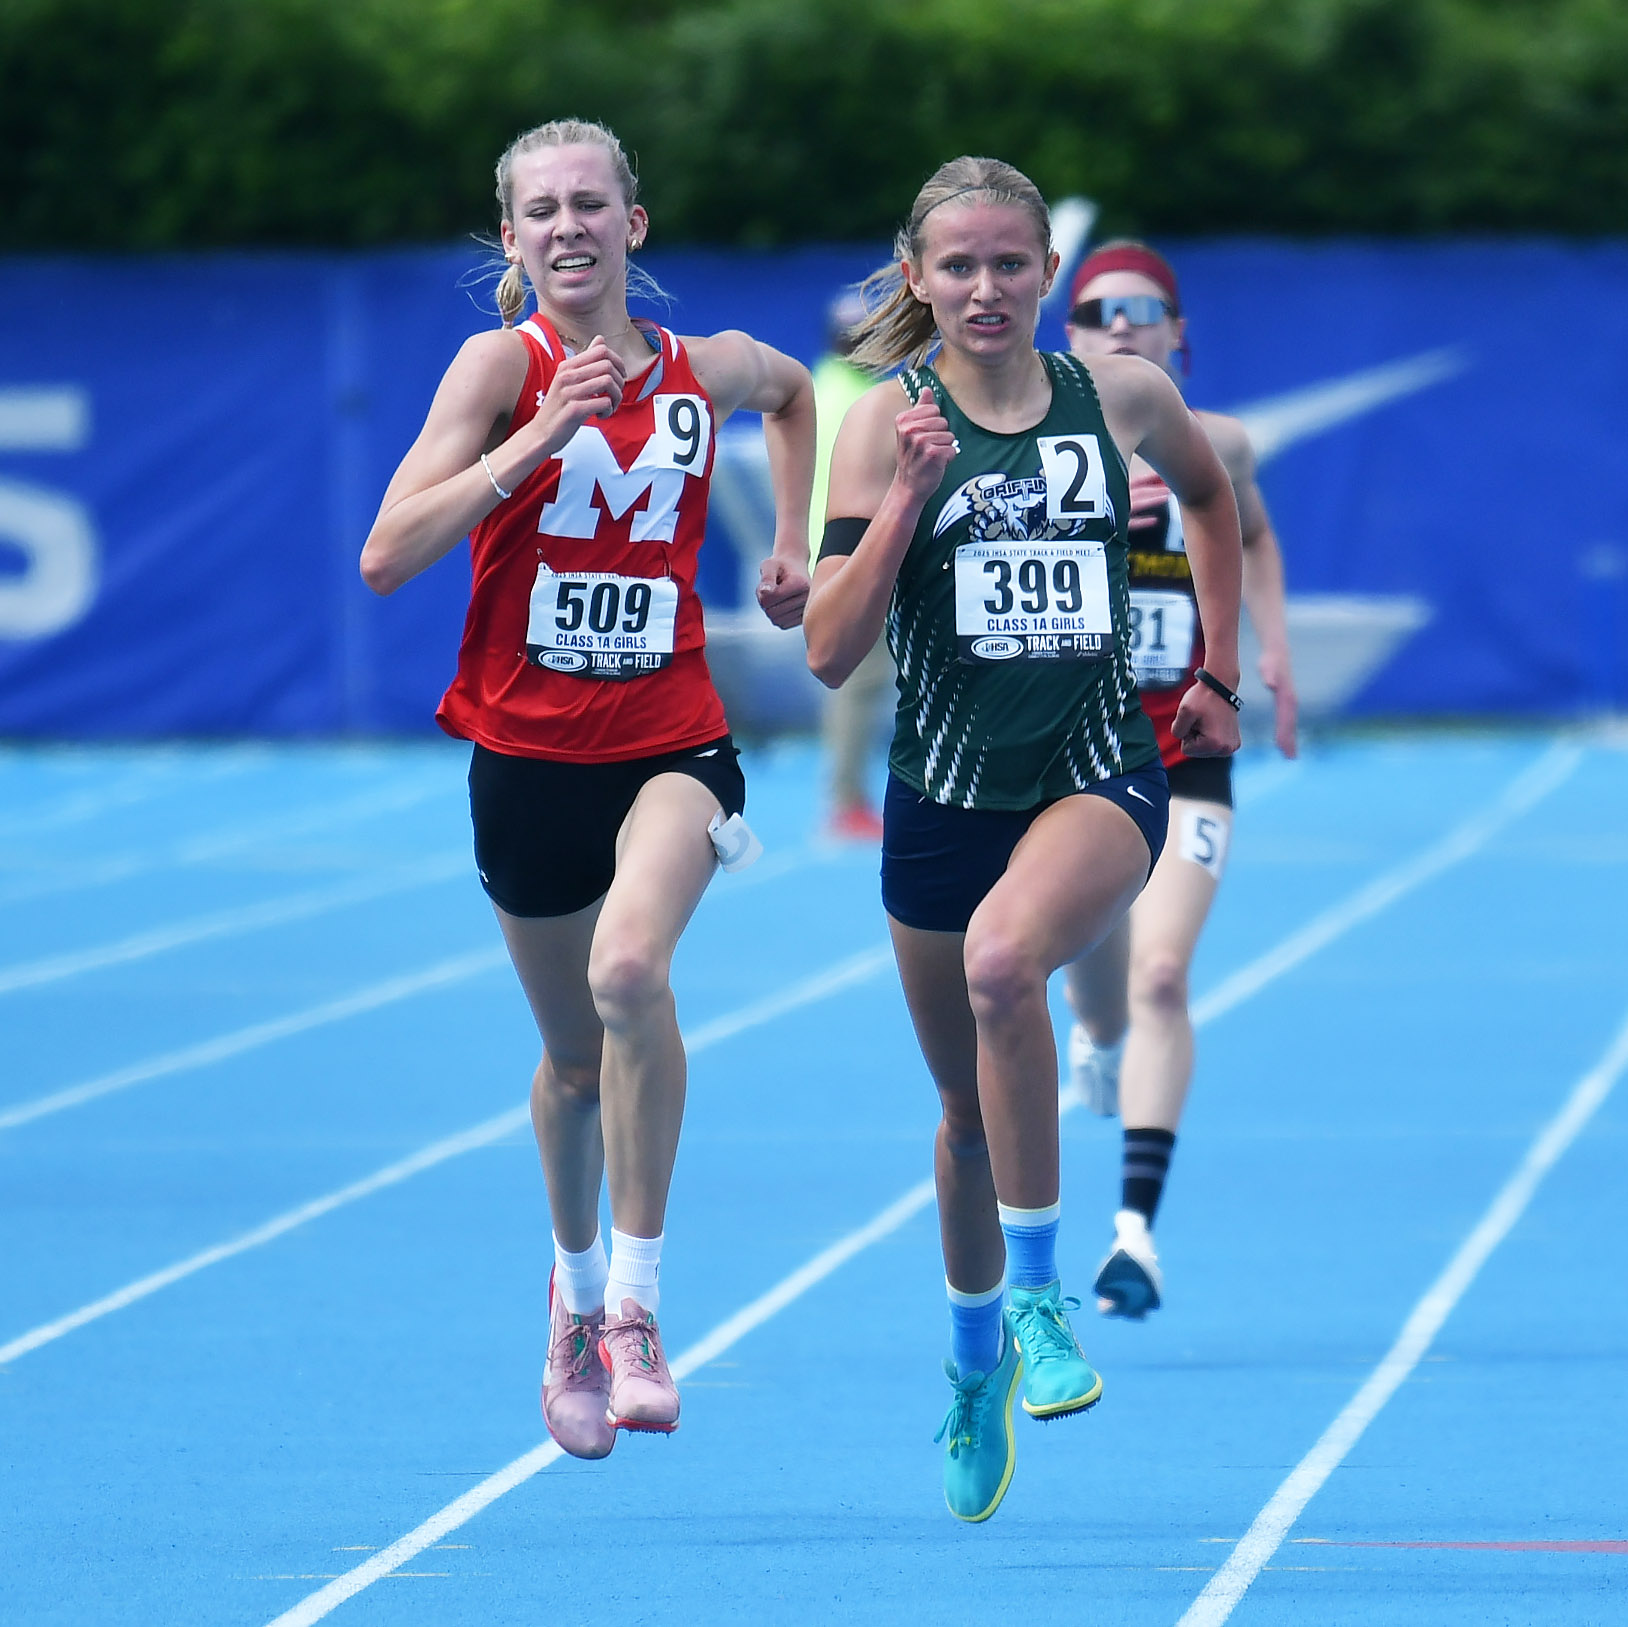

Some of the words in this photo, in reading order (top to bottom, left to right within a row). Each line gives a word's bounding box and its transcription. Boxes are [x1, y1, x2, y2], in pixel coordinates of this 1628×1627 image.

[667, 398, 701, 467] 9
[537, 425, 686, 544] M
[1054, 440, 1095, 513] 2
[1010, 549, 1027, 557] STATE
[1030, 549, 1048, 557] TRACK
[1057, 549, 1074, 557] FIELD
[1075, 549, 1091, 557] MEET
[555, 581, 652, 634] 509
[983, 559, 1083, 614] 399
[555, 633, 594, 648] CLASS
[597, 636, 611, 649] 1A
[614, 636, 647, 649] GIRLS
[987, 618, 1028, 631] CLASS
[1032, 618, 1048, 631] 1A
[1051, 617, 1085, 630] GIRLS
[1026, 635, 1060, 651] TRACK
[1073, 634, 1102, 651] FIELD
[591, 653, 621, 669] TRACK
[635, 654, 662, 669] FIELD
[1193, 816, 1217, 865] 5
